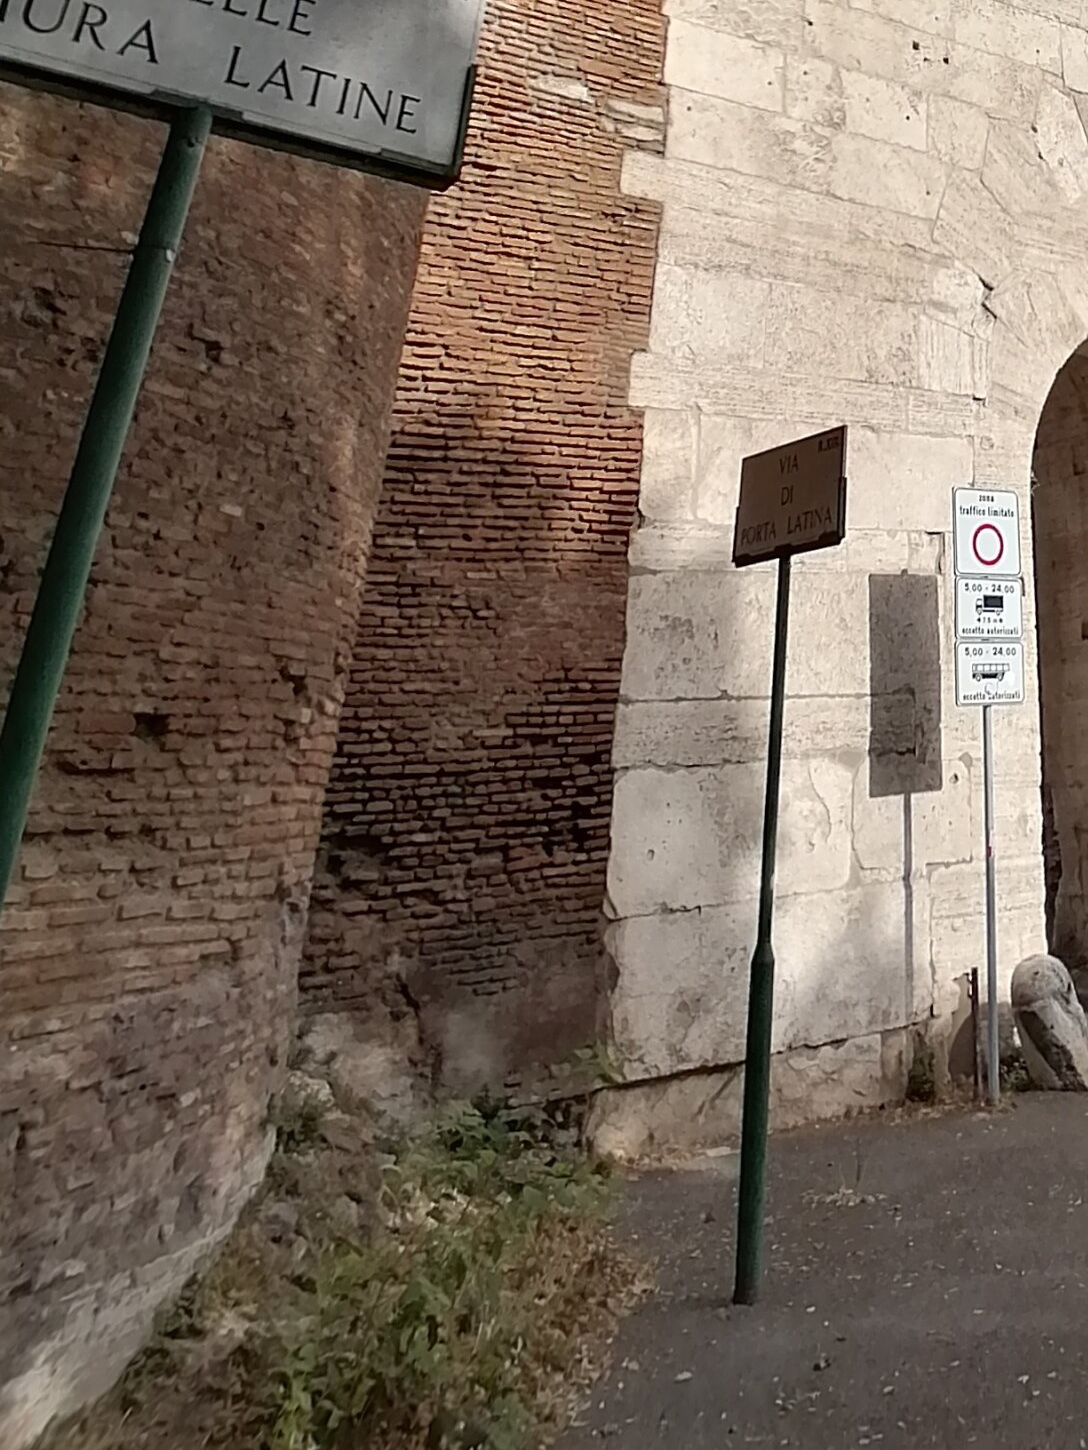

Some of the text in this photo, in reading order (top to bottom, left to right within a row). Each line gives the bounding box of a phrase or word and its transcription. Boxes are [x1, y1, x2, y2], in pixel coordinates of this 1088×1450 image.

[223, 46, 422, 135] LATINE
[780, 454, 799, 475] VIA
[781, 485, 794, 506] DI
[959, 505, 1015, 518] traffico limitato
[741, 507, 832, 546] PORTA LATINA
